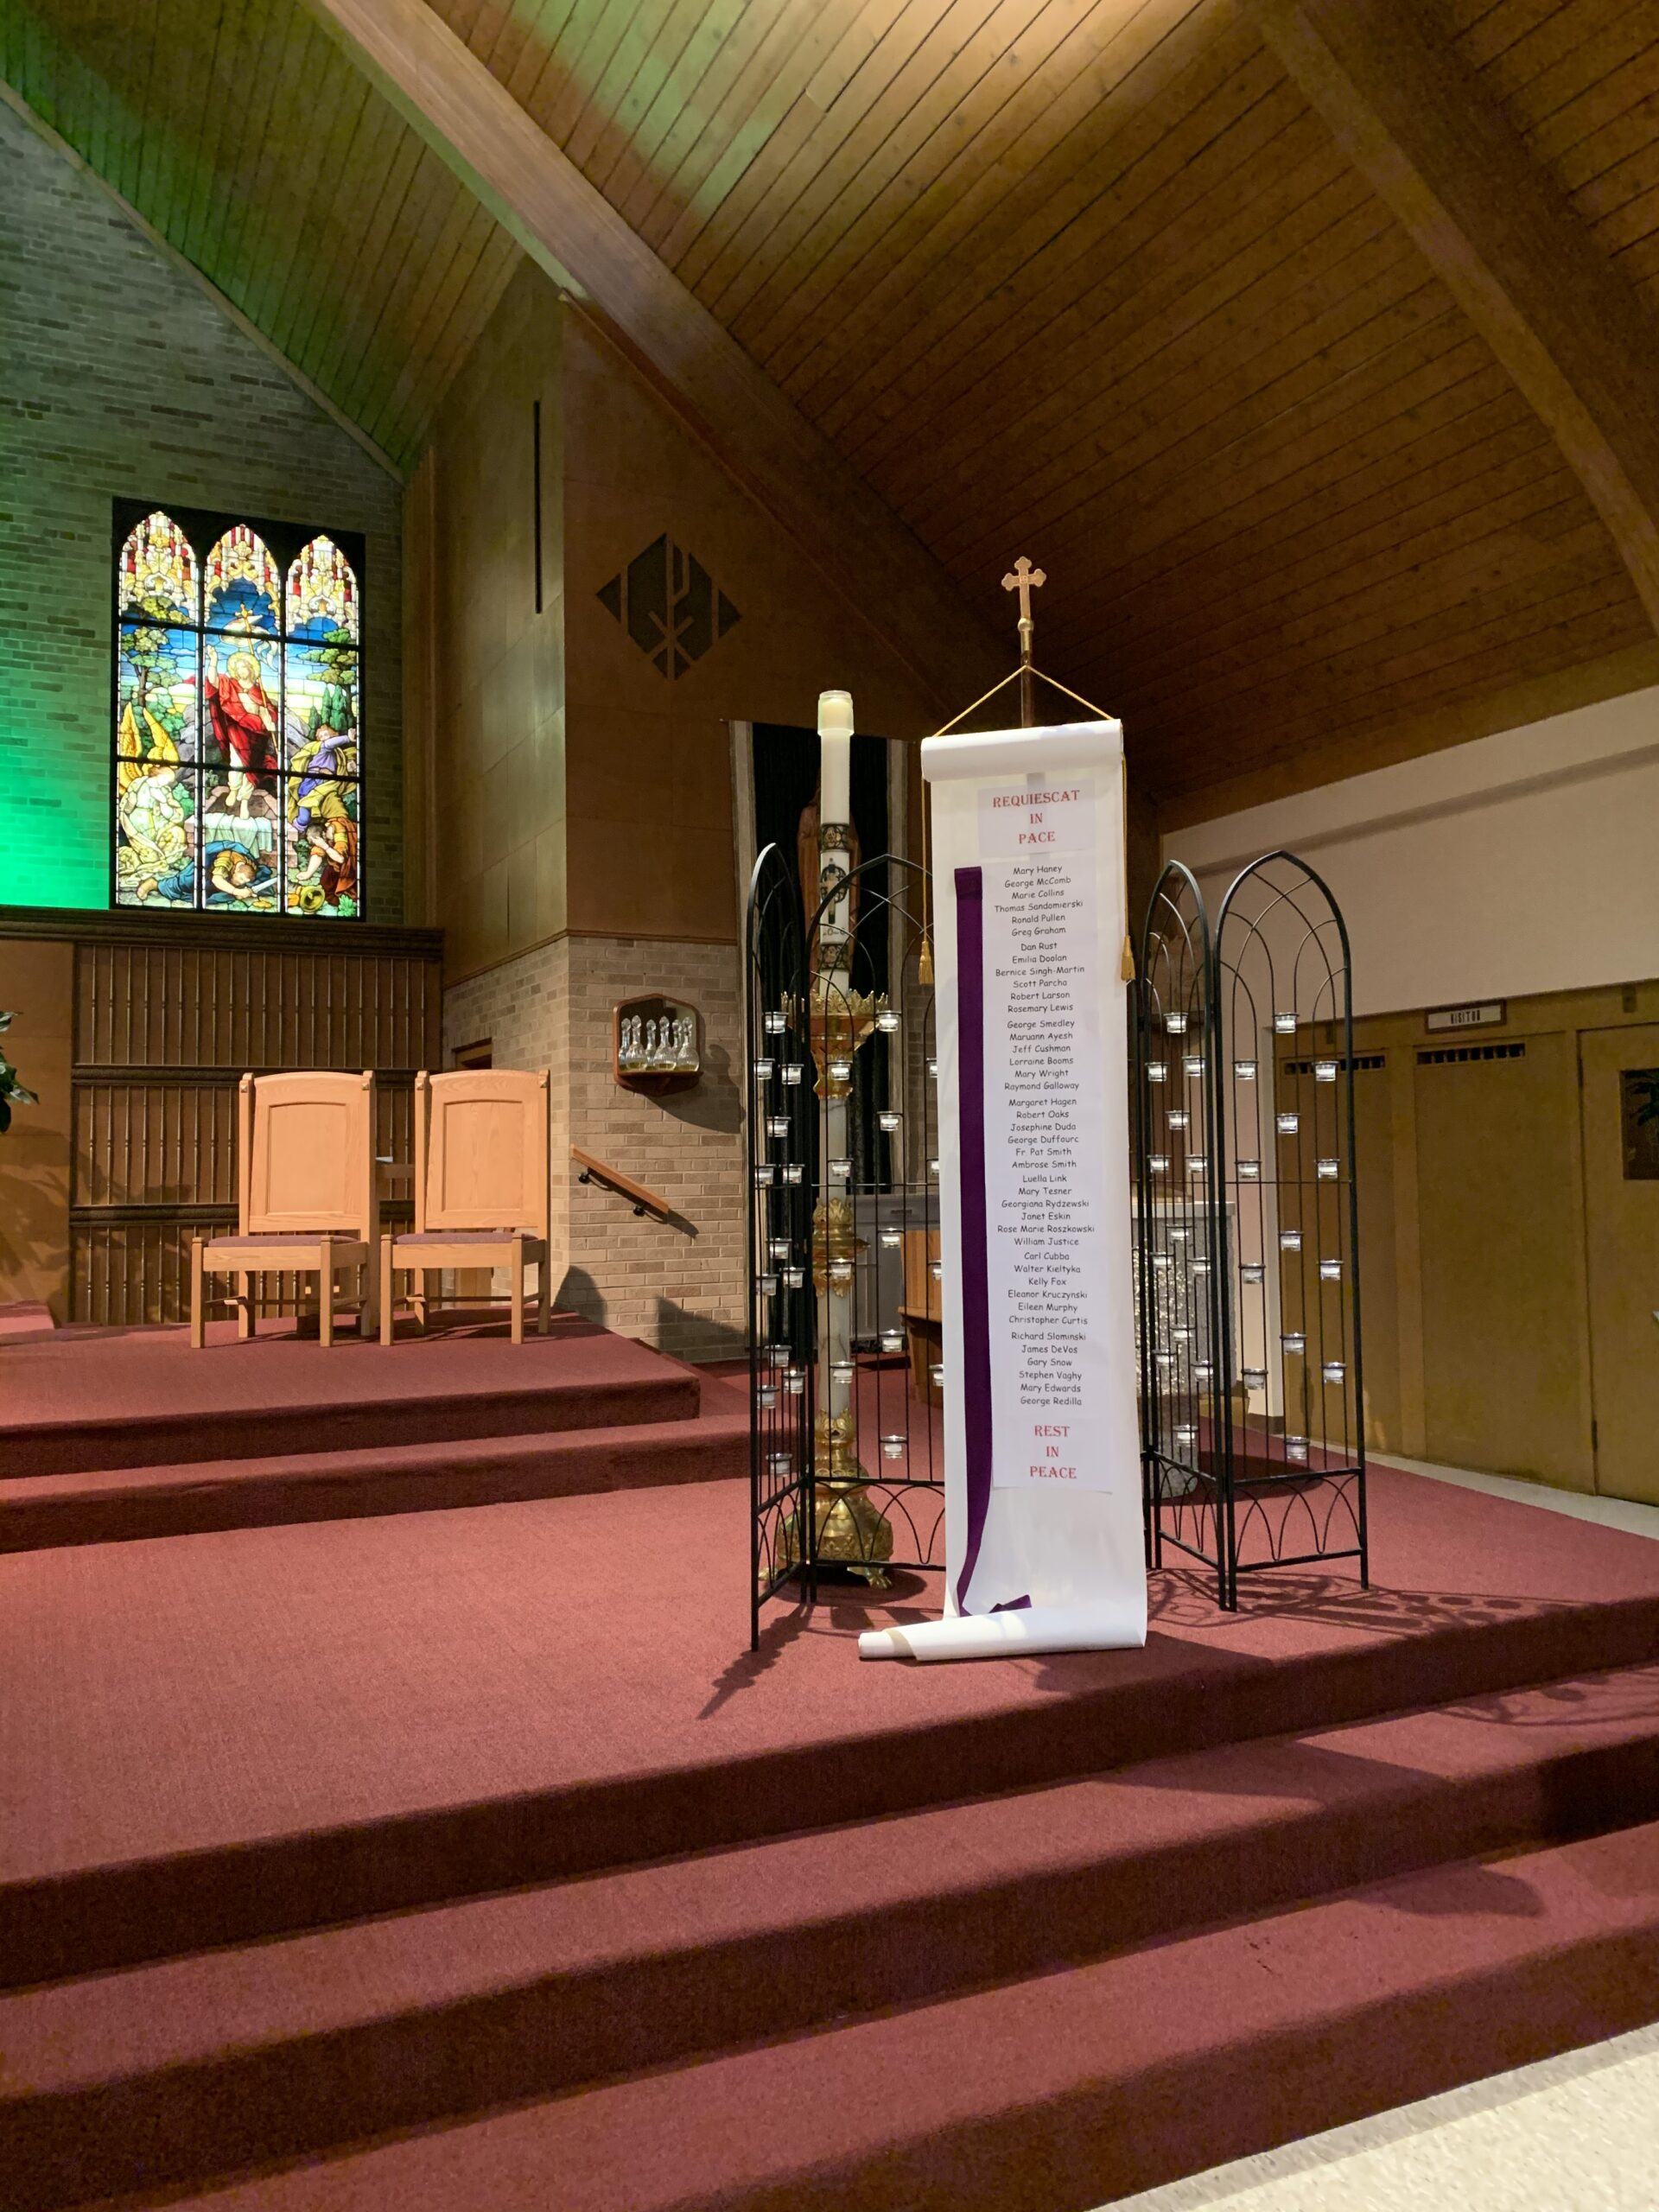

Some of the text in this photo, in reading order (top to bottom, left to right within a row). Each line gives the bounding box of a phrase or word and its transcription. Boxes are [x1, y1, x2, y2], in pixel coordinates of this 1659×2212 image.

[993, 790, 1079, 807] REQUIESCAT
[1030, 813, 1042, 823] IN
[1019, 831, 1055, 843] PACE
[1005, 876, 1071, 889] George McComb
[1038, 889, 1064, 898] Collins
[1028, 899, 1083, 911] Sandomierski
[1012, 915, 1039, 924] Ronald
[1012, 926, 1065, 937] Greg Graham
[1020, 943, 1036, 951] Dan
[1039, 954, 1066, 963] Doolan
[1030, 966, 1084, 976] Singh-Martin
[1007, 1005, 1047, 1014] Rosemary
[1007, 1020, 1075, 1030] George Smedley
[1047, 1032, 1072, 1041] Ayesh
[1013, 1045, 1031, 1053] Jeff
[1014, 1069, 1068, 1079] Mary Wright
[1004, 1081, 1079, 1091] Raymond Galloway
[1008, 1098, 1077, 1109] Margaret Hagen
[1010, 1123, 1052, 1133] Josephine
[1007, 1135, 1037, 1146] George
[1023, 1174, 1047, 1183] Luella
[1018, 1187, 1039, 1197] Mary
[1001, 1199, 1089, 1210] Georgiana Rydzewski
[1048, 1211, 1071, 1220] Eskin
[1047, 1224, 1094, 1233] Roszkowski
[1028, 1277, 1048, 1287] Kelly
[1007, 1289, 1087, 1300] Eleanor Kruczynski
[1018, 1302, 1077, 1313] Eileen Murphy
[1009, 1315, 1087, 1325] Christopher Curtis
[1021, 1344, 1077, 1353] James DeVos
[1027, 1357, 1047, 1368] Gary
[1020, 1370, 1053, 1380] Stephen
[1020, 1383, 1081, 1393] Mary Edwards
[1020, 1395, 1082, 1407] George Redilla
[1034, 1425, 1070, 1437] REST
[1046, 1446, 1058, 1457] IN
[1030, 1465, 1077, 1478] PEACE
